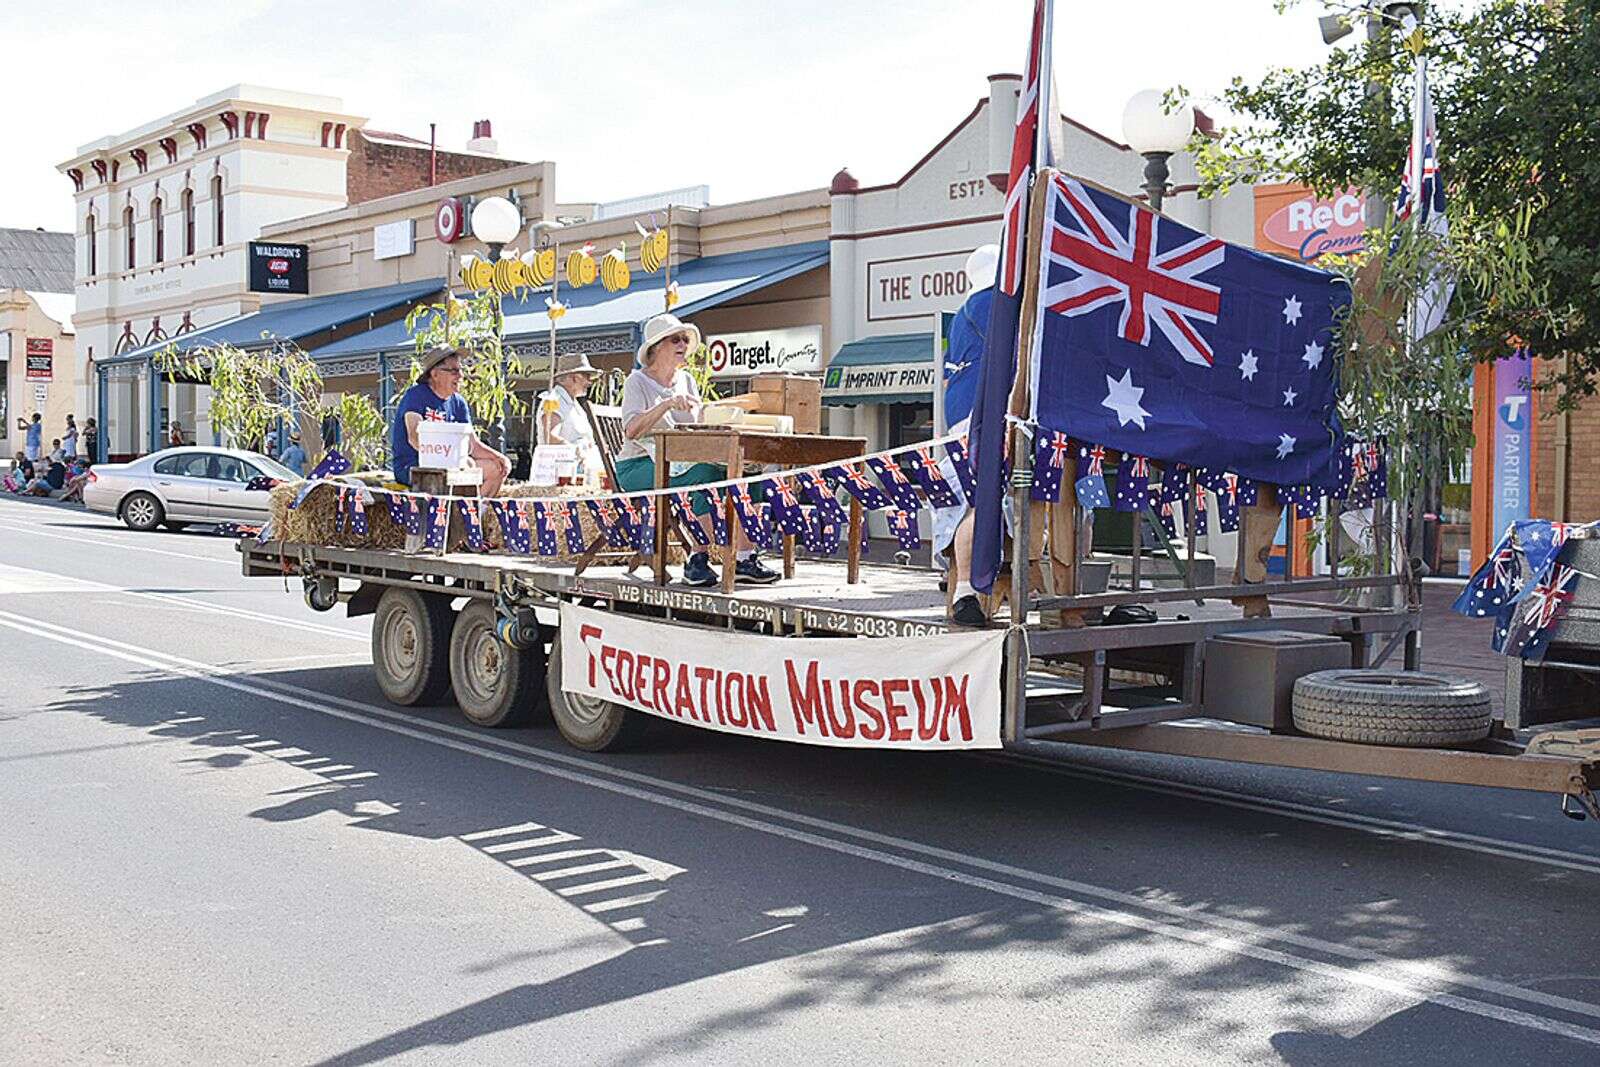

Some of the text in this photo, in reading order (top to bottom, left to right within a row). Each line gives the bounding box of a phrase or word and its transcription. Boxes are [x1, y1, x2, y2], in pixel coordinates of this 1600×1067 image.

[879, 270, 973, 302] THE CORO
[525, 364, 557, 378] Count
[777, 343, 818, 369] Country
[845, 371, 897, 388] IMPRINT
[1503, 432, 1520, 509] PARTNER
[643, 588, 703, 611] HUNTER
[854, 616, 897, 638] 6033
[580, 623, 973, 742] FEDERATION MUSEUM
